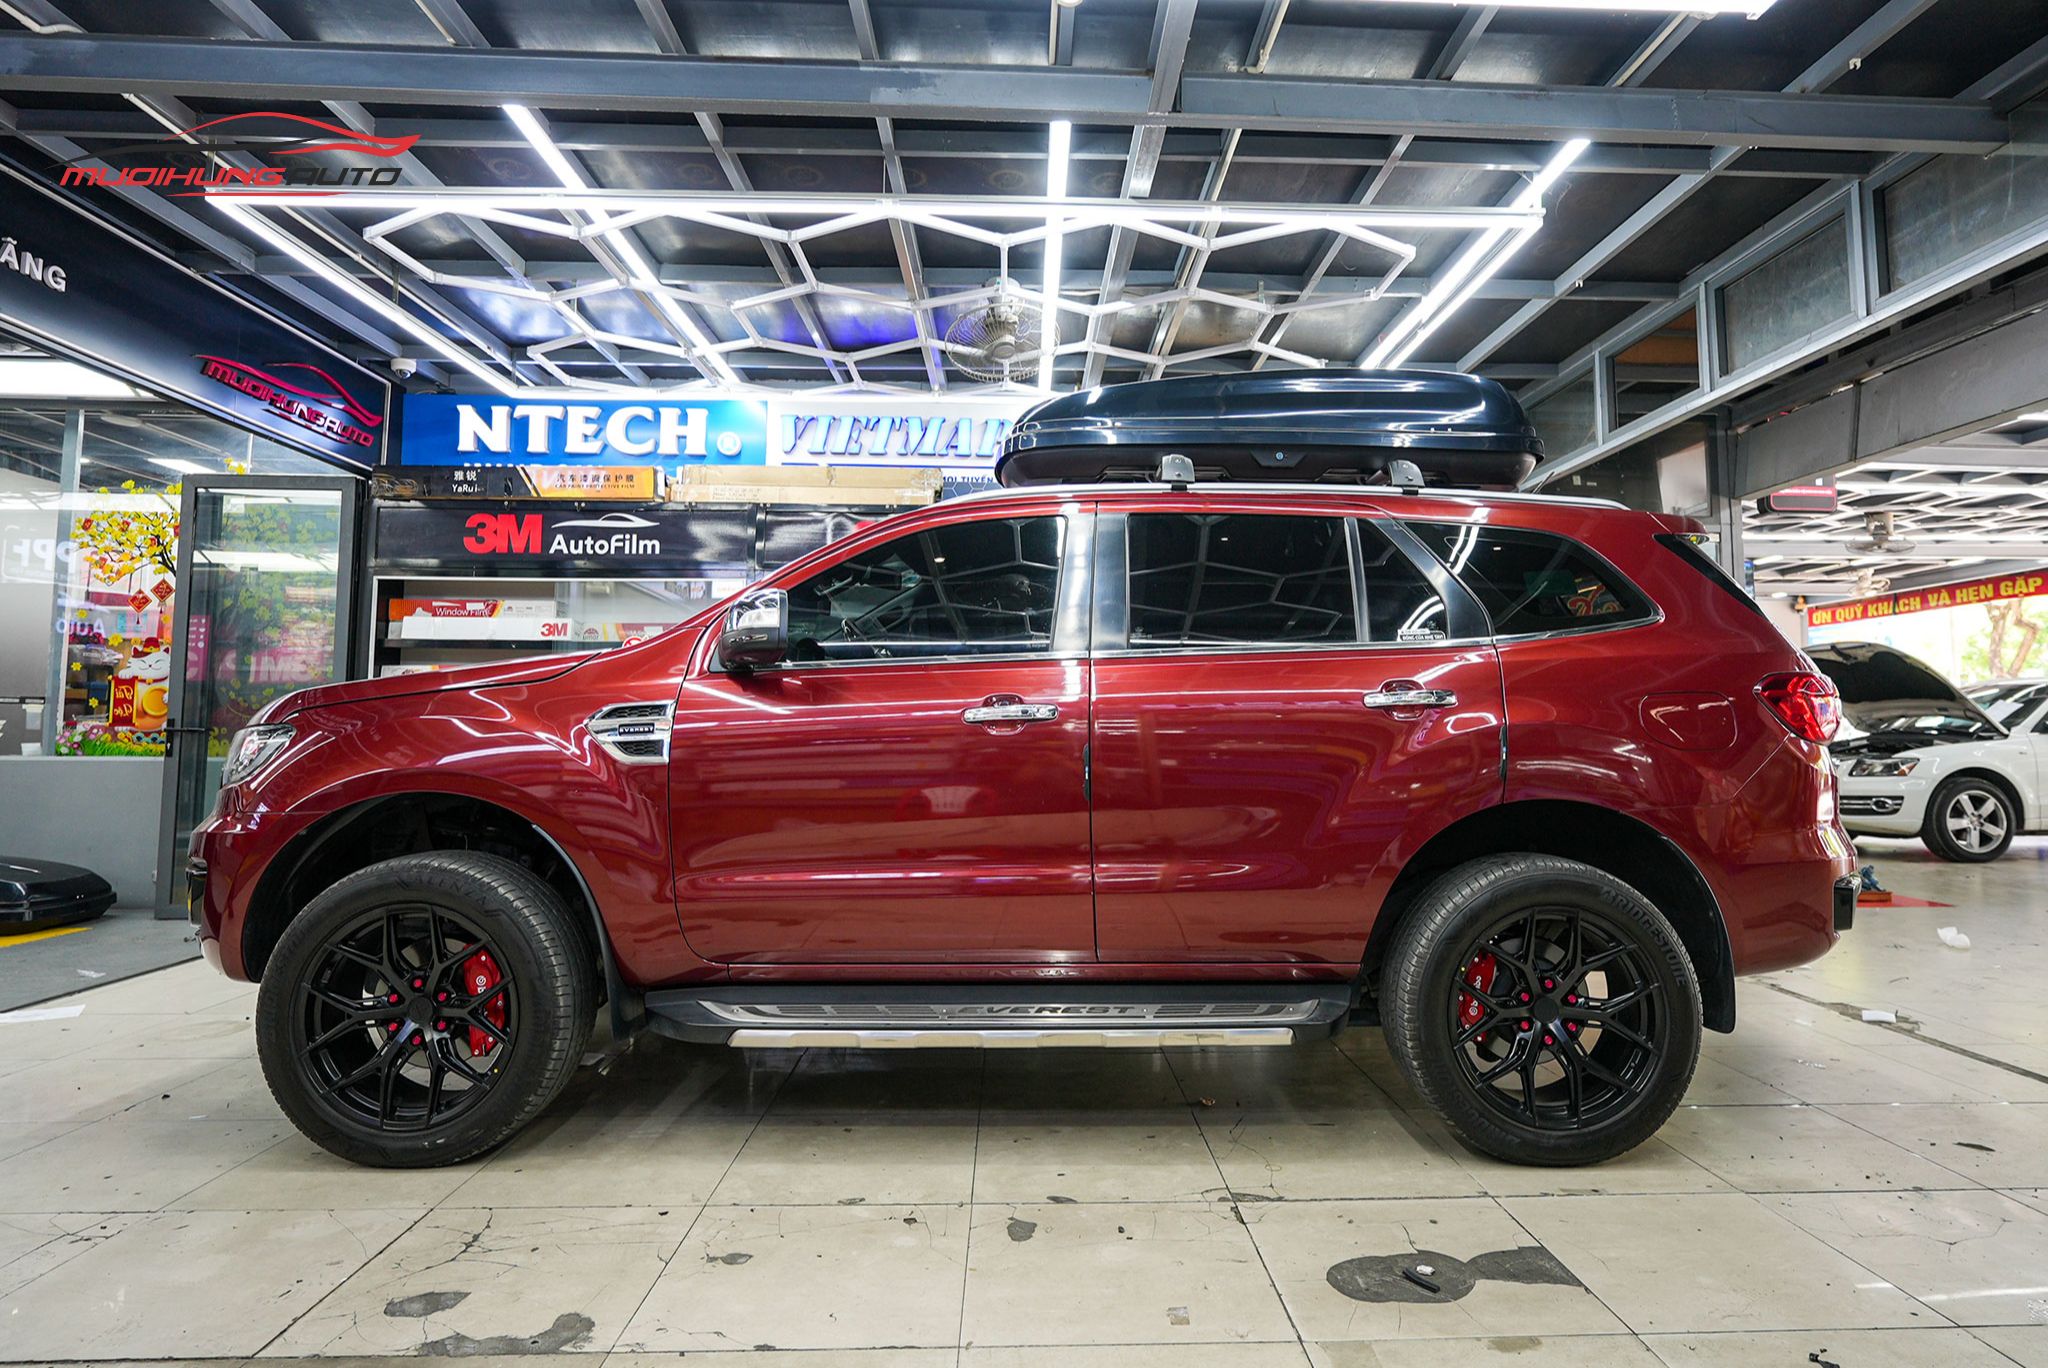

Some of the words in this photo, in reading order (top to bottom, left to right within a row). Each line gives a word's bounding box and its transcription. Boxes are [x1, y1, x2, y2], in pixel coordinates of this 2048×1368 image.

[452, 483, 478, 493] YaRui
[463, 513, 543, 554] 3M
[549, 533, 660, 555] AutoFilm
[1928, 589, 1951, 607] VÀ
[1955, 584, 1994, 603] HẸN
[2000, 576, 2043, 598] GẶP
[436, 606, 469, 616] Window
[541, 622, 568, 637] 3M
[1600, 886, 1688, 987] BRIDGESTONE
[957, 1006, 1135, 1014] EVEREST
